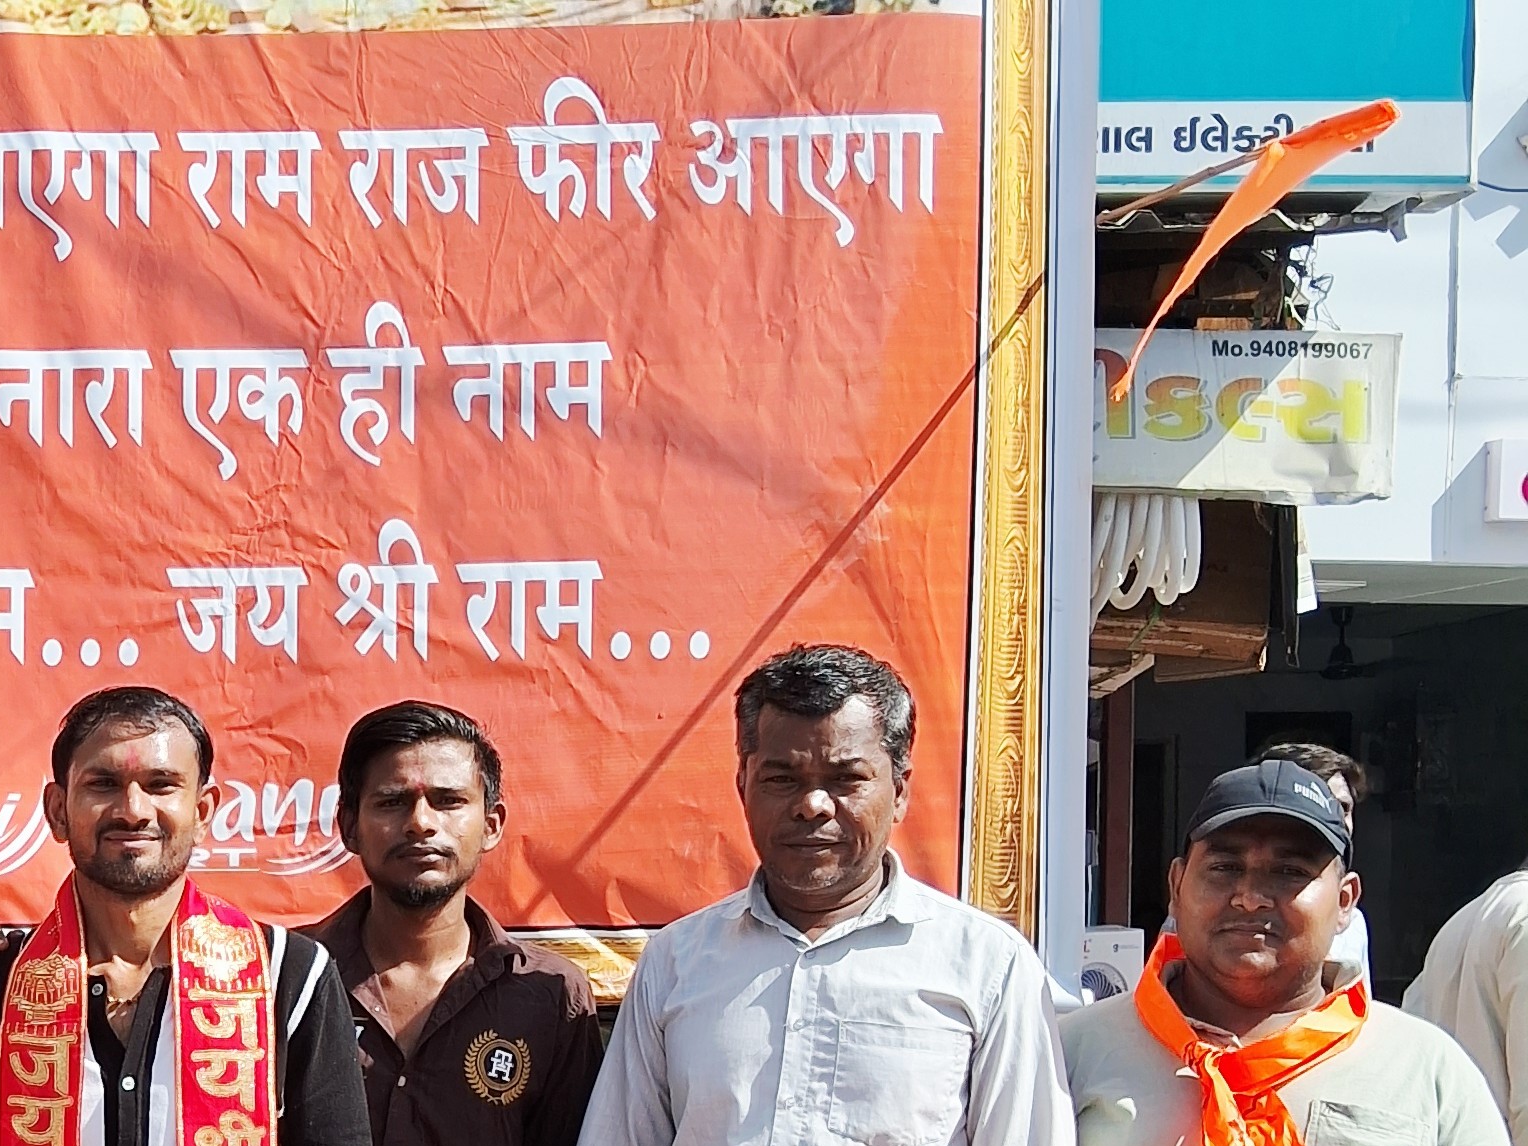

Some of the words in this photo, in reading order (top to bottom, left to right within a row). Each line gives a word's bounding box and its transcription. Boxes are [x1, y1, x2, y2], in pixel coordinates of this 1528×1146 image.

[177, 130, 322, 228] राम
[338, 127, 489, 228] राज
[504, 77, 660, 222] फीर
[689, 106, 944, 247] आएगा
[169, 349, 309, 480] एक
[326, 301, 425, 466] ही
[442, 342, 613, 441] नाम
[1211, 339, 1373, 360] Mo.9408199067
[166, 566, 308, 664] जय
[335, 519, 439, 663] श्री
[1294, 782, 1326, 809] PUMA
